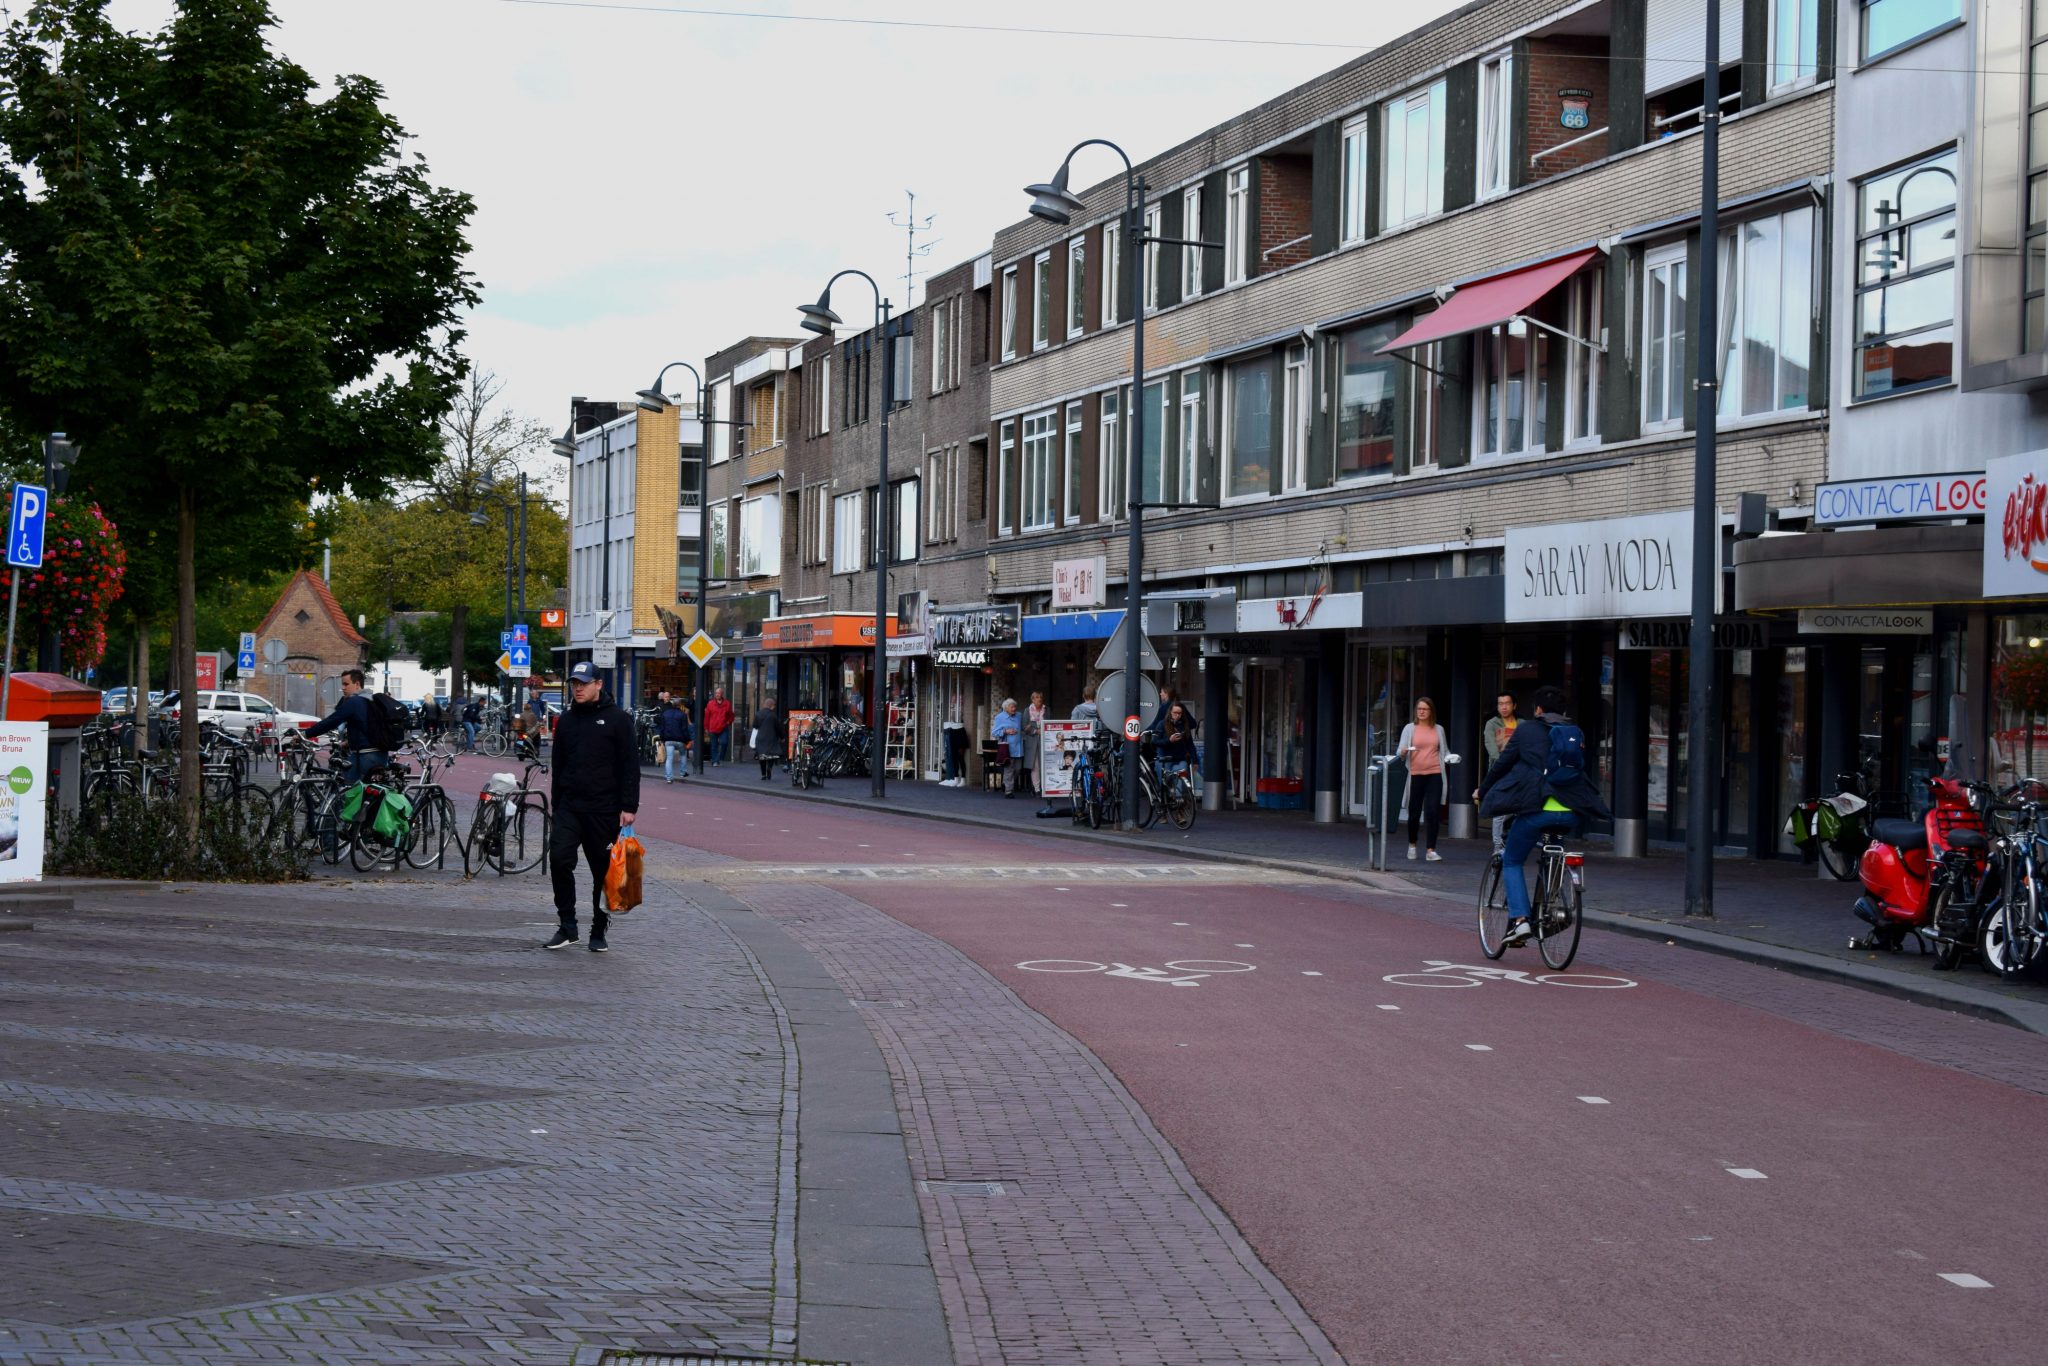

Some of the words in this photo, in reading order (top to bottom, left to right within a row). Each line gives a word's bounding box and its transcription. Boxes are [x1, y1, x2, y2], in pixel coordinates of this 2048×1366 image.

[1565, 114, 1584, 127] 66
[19, 492, 40, 531] P
[1524, 544, 1591, 597] SARAY
[1602, 537, 1677, 593] MODA
[1814, 614, 1924, 628] CONTACTALOOK
[937, 650, 986, 664] ADANA
[1127, 722, 1140, 734] 30
[8, 734, 32, 742] Brown
[2, 744, 23, 753] Bruna
[11, 776, 31, 784] NIEUW
